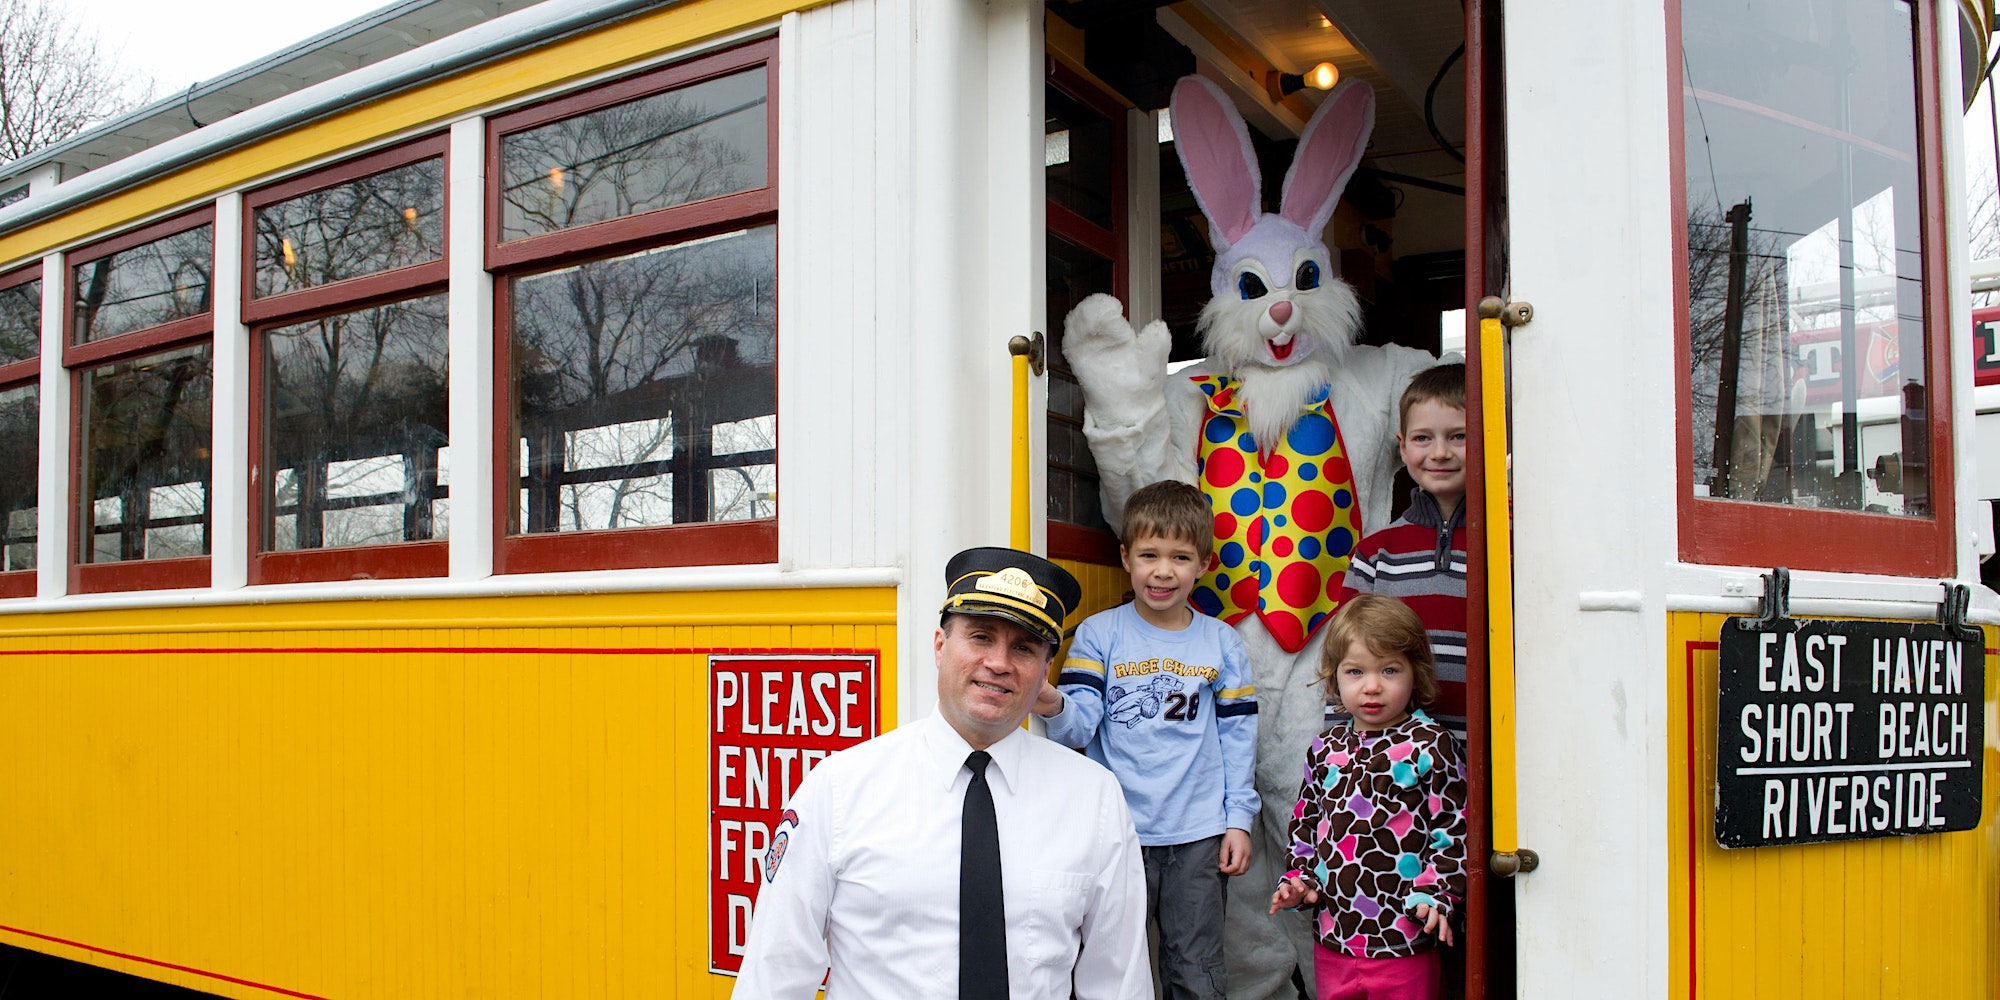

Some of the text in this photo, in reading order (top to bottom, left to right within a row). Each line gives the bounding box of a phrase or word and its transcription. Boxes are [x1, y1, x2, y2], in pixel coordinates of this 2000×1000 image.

[1114, 657, 1219, 682] RACE CHAMP
[1758, 632, 1962, 695] EAST HAVEN
[716, 671, 863, 738] PLEASE
[1164, 692, 1200, 721] 28
[1740, 702, 1968, 763] SHORT BEACH
[718, 745, 843, 810] ENT
[1762, 772, 1947, 839] RIVERSIDE
[720, 820, 768, 883] FR
